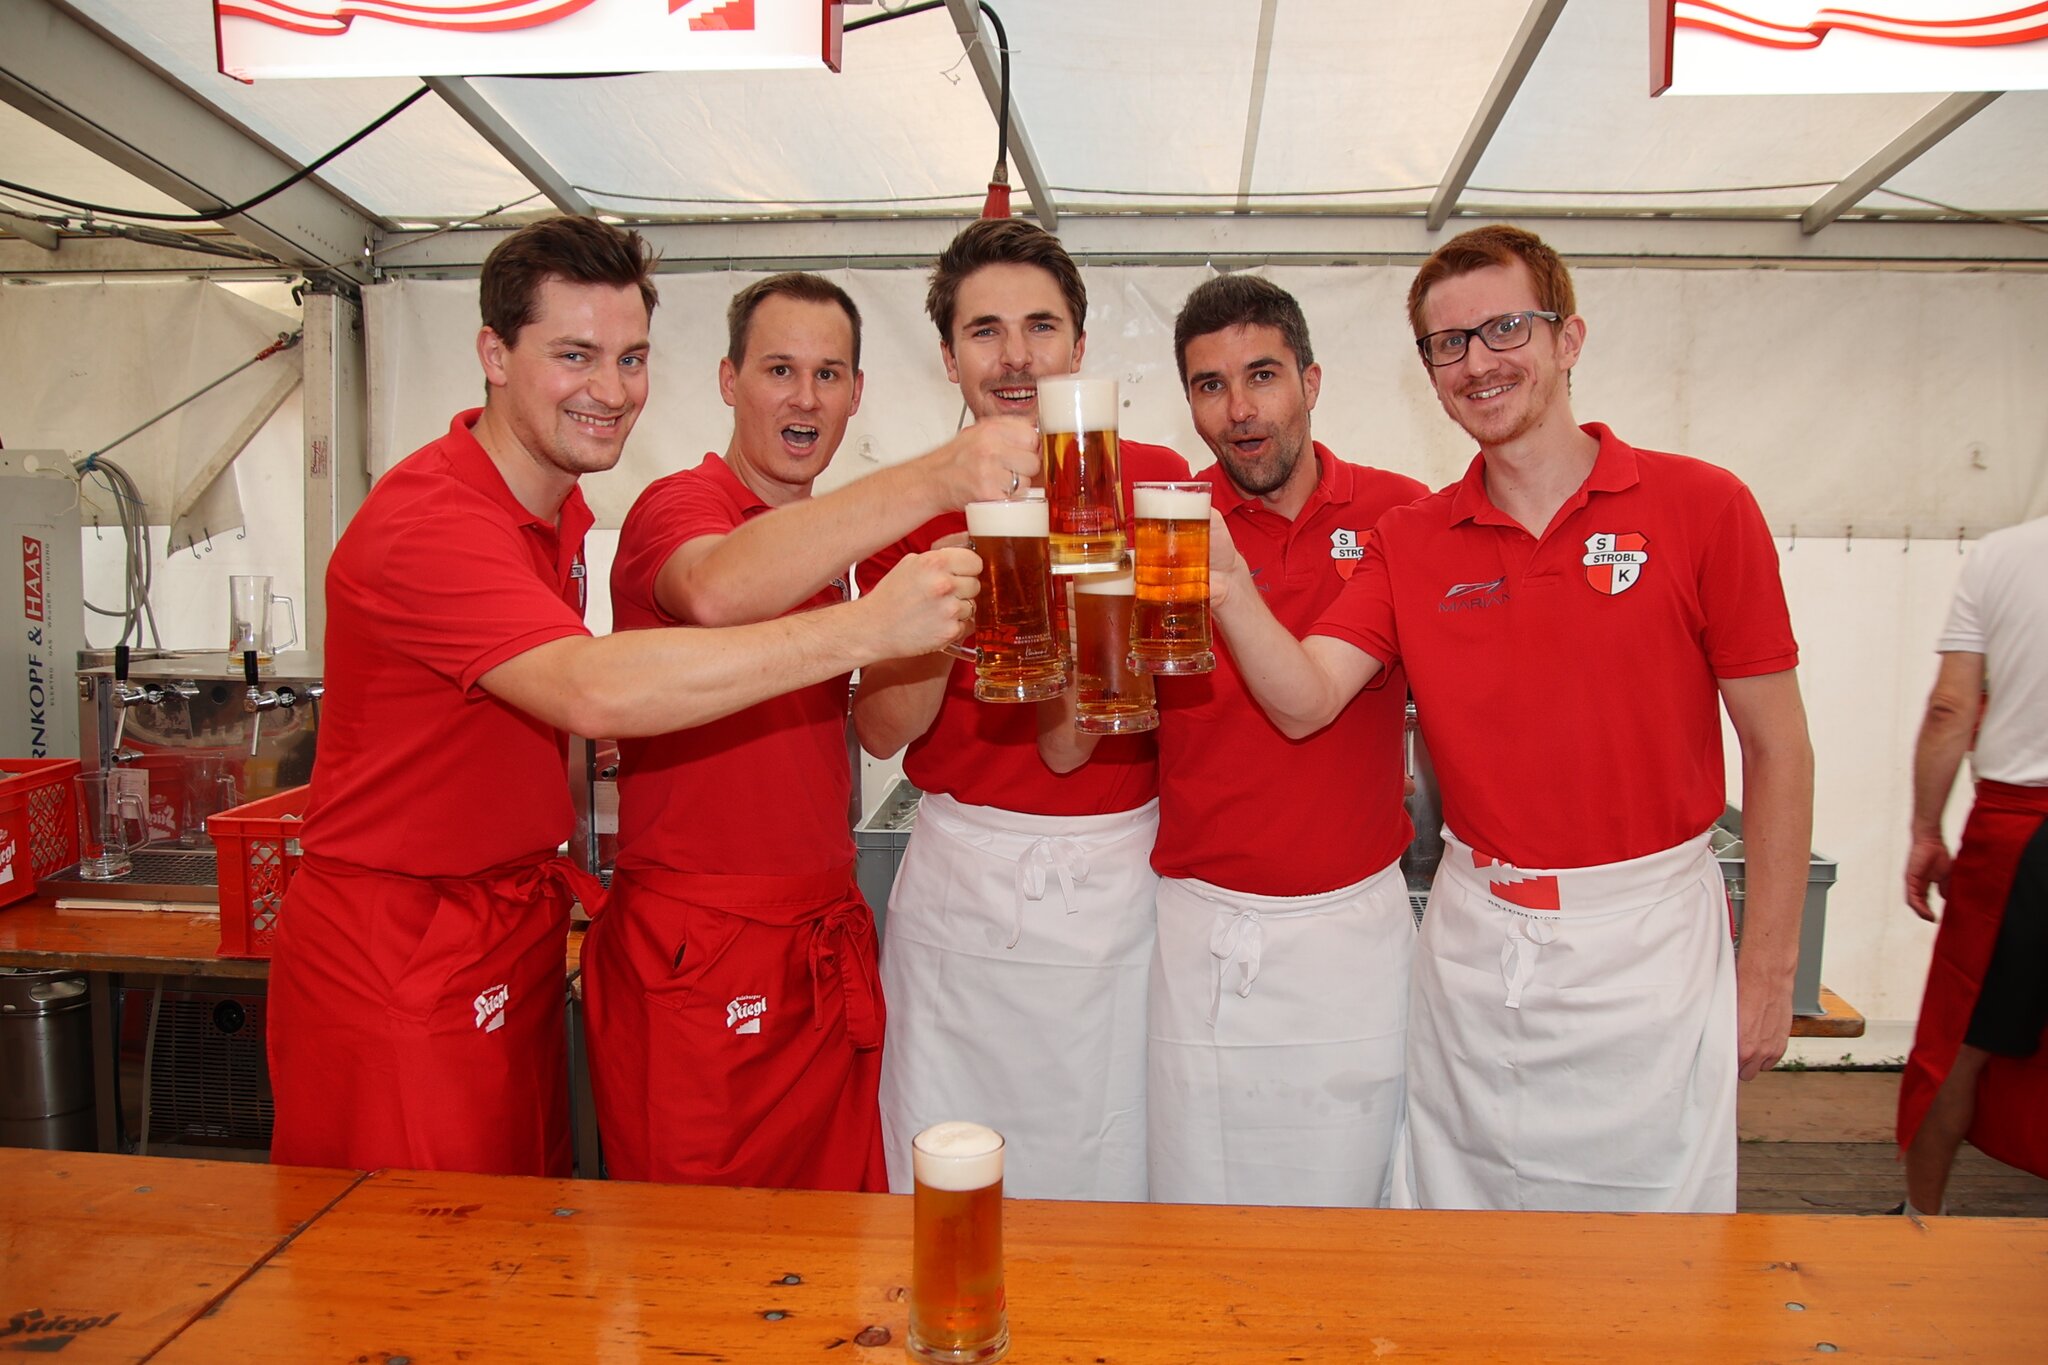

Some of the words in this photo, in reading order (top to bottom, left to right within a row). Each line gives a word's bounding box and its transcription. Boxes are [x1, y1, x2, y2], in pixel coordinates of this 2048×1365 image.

[1339, 533, 1349, 545] S
[1596, 538, 1606, 550] S
[1339, 549, 1364, 557] STRO
[1593, 553, 1637, 563] STROBL
[24, 542, 42, 617] HAAS
[1618, 569, 1631, 582] K
[27, 626, 42, 646] &
[28, 653, 46, 758] RNKOPF
[474, 984, 509, 1029] Stiegl
[726, 996, 767, 1028] Stiegl
[0, 1308, 122, 1337] Stiegl
